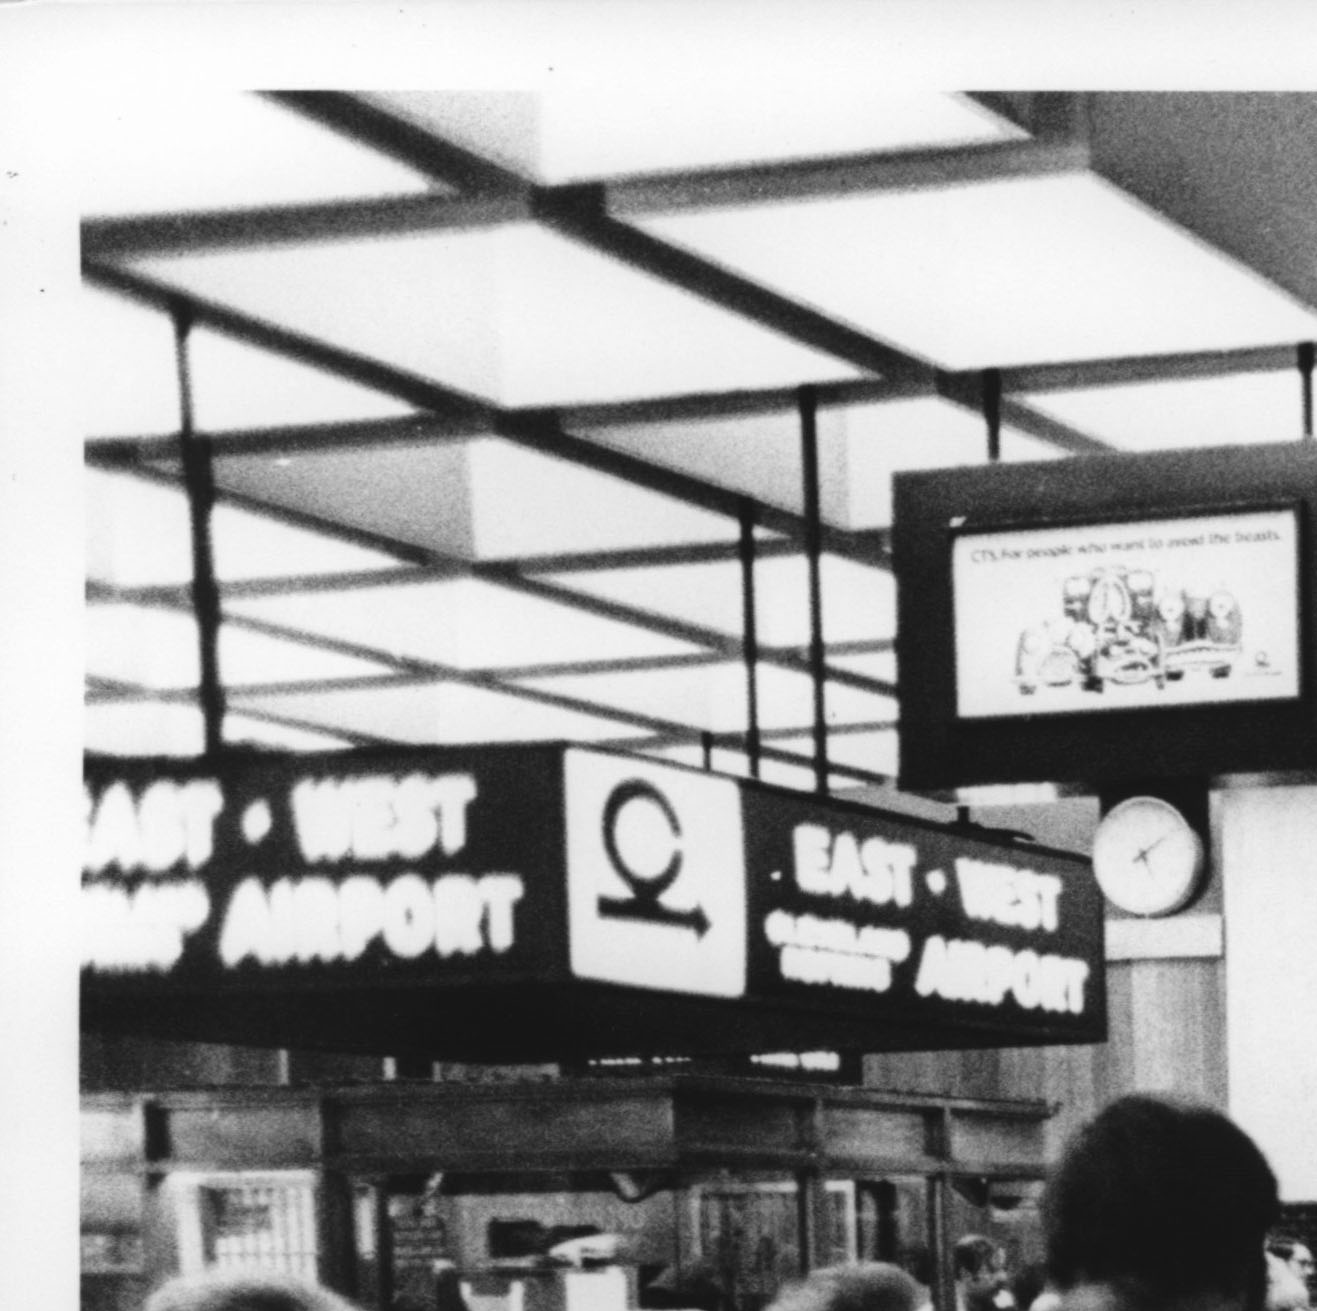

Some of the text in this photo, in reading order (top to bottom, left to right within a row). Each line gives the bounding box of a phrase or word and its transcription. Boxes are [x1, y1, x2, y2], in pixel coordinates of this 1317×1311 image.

[1209, 531, 1231, 545] the
[289, 771, 478, 864] WEST
[217, 871, 525, 970] AIRPORT
[793, 821, 1064, 932] EAST WEST
[914, 934, 1090, 1015] AIRPORT
